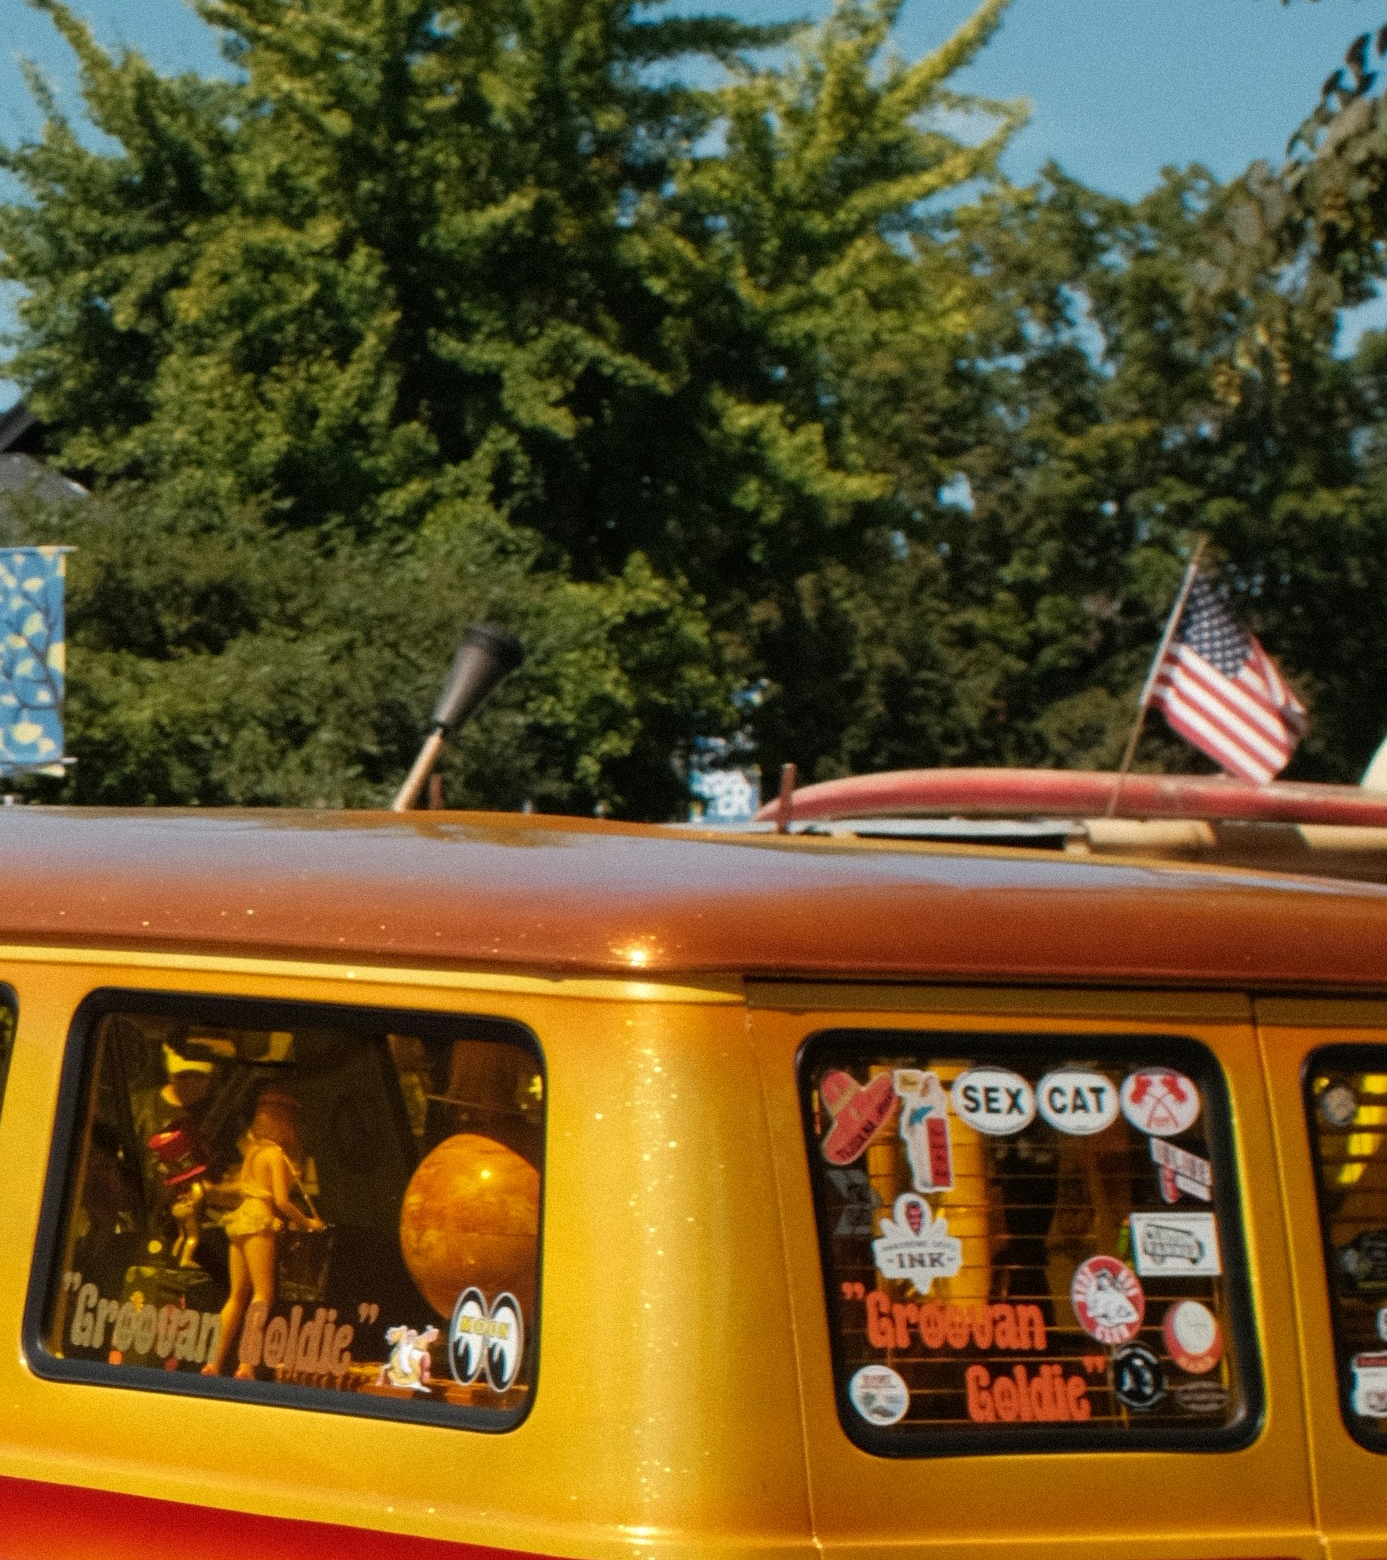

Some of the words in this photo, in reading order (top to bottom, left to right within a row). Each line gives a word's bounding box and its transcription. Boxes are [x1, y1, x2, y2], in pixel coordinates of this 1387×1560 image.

[963, 1084, 1026, 1116] SEX
[1048, 1085, 1108, 1115] CAT
[895, 1252, 948, 1269] INK
